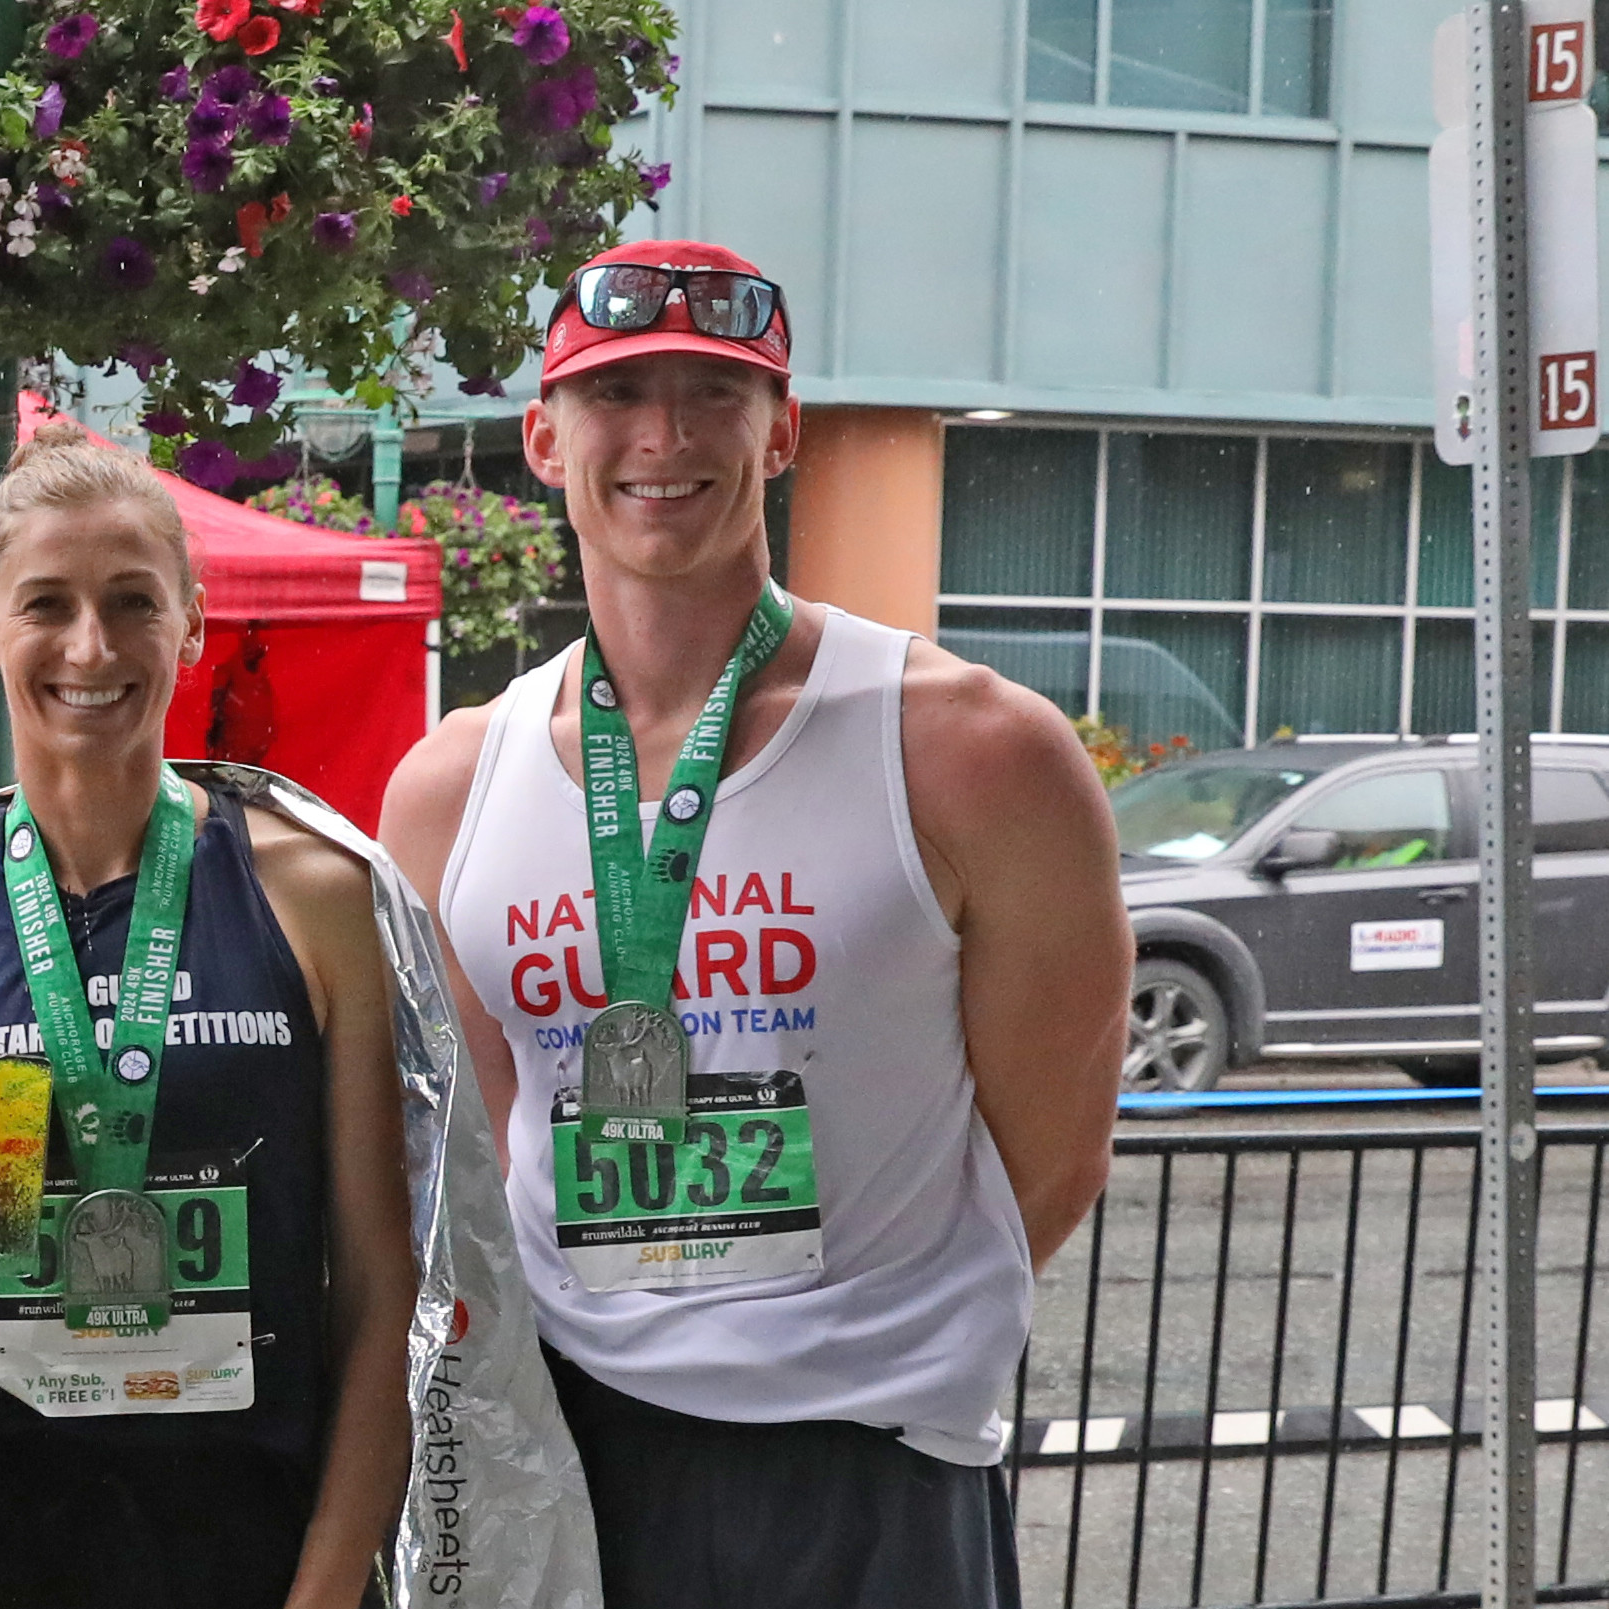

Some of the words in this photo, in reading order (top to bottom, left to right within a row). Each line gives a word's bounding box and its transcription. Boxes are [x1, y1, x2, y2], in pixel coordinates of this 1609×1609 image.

[1537, 31, 1579, 94] 15
[1546, 359, 1590, 423] 15
[614, 735, 629, 765] 2024
[587, 732, 619, 839] FINISHER
[618, 768, 634, 792] 49K
[34, 870, 51, 901] 2024
[606, 861, 622, 924] RUNNING
[42, 902, 57, 927] 49K
[507, 872, 816, 946] NANAL
[12, 878, 54, 977] FINISHER
[126, 966, 143, 990] 49K
[137, 926, 177, 1026] FINISHER
[121, 991, 137, 1023] 2024
[731, 1006, 816, 1034] TEAM
[60, 995, 88, 1073] ANCHORAGE
[60, 1049, 78, 1085] CLUB
[600, 1122, 625, 1139] 49K
[628, 1124, 665, 1141] ULTRA
[574, 1119, 791, 1215] 5032
[581, 1225, 646, 1242] #runwildak
[738, 1220, 761, 1229] CLUB
[637, 1241, 735, 1265] SUBWAY
[18, 1302, 65, 1316] #runwil
[86, 1310, 110, 1327] 49K
[112, 1309, 149, 1326] ULTRA
[38, 1375, 67, 1389] Any
[71, 1372, 106, 1387] Sub,
[48, 1390, 88, 1404] FREE
[426, 1354, 471, 1596] Heatsheets
